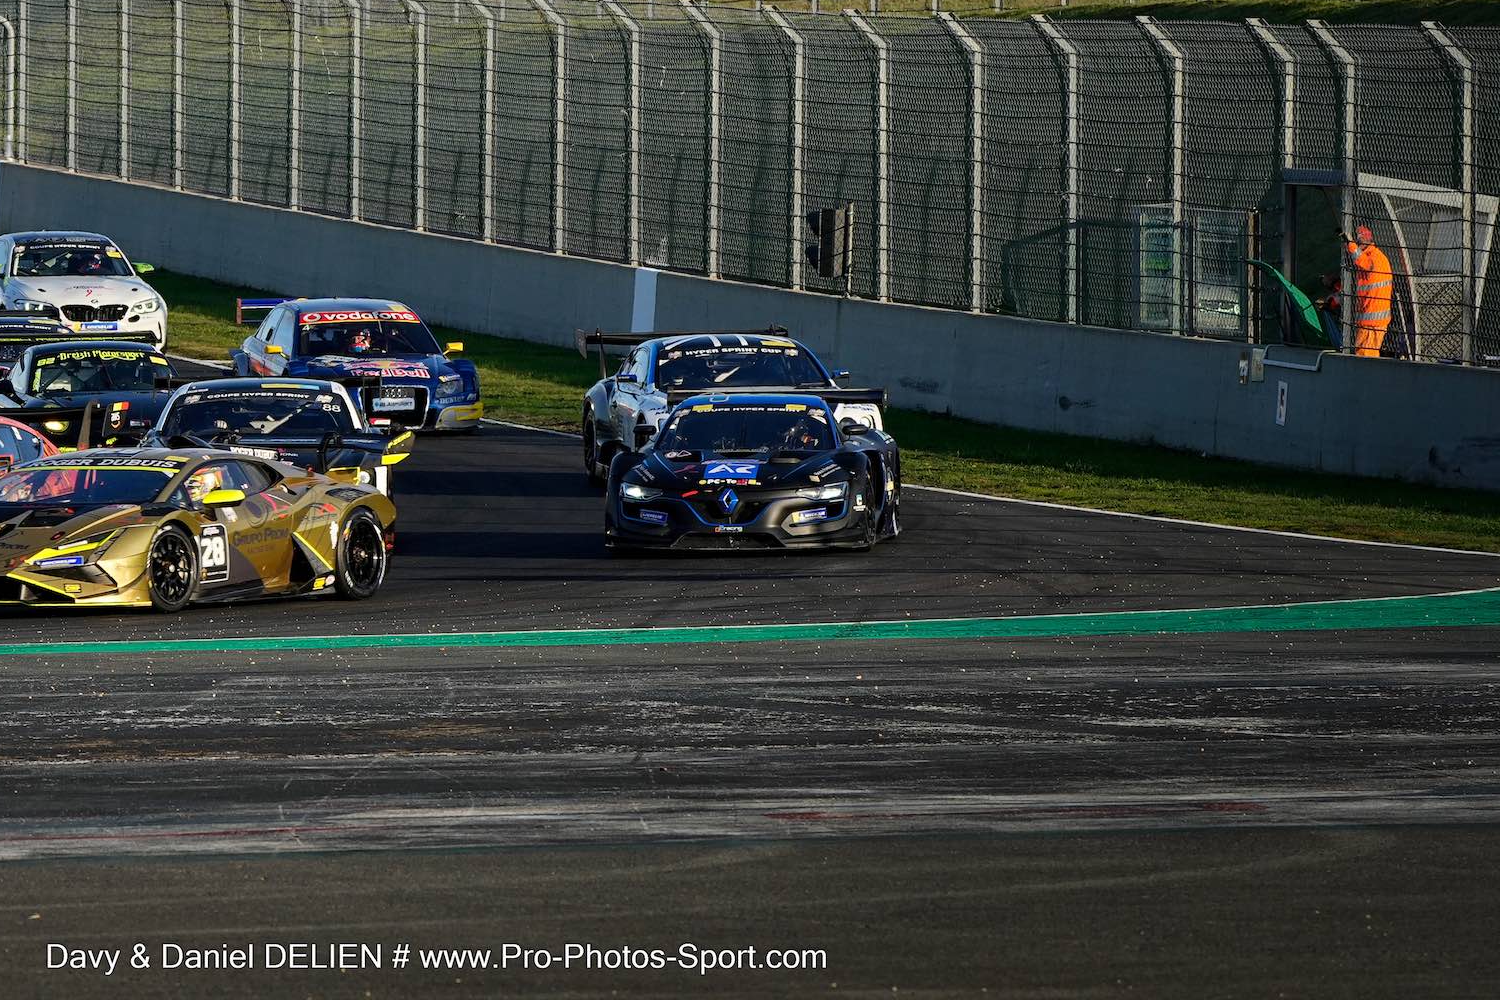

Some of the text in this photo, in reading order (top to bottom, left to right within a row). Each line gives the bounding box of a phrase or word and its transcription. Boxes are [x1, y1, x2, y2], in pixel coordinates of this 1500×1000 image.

[325, 311, 415, 321] vodafone
[92, 350, 145, 361] Motorsport
[685, 348, 719, 356] HYPER
[392, 369, 430, 379] Bull
[322, 403, 341, 413] 88
[30, 458, 177, 468] ROGER DUBUIS
[200, 536, 225, 568] 28
